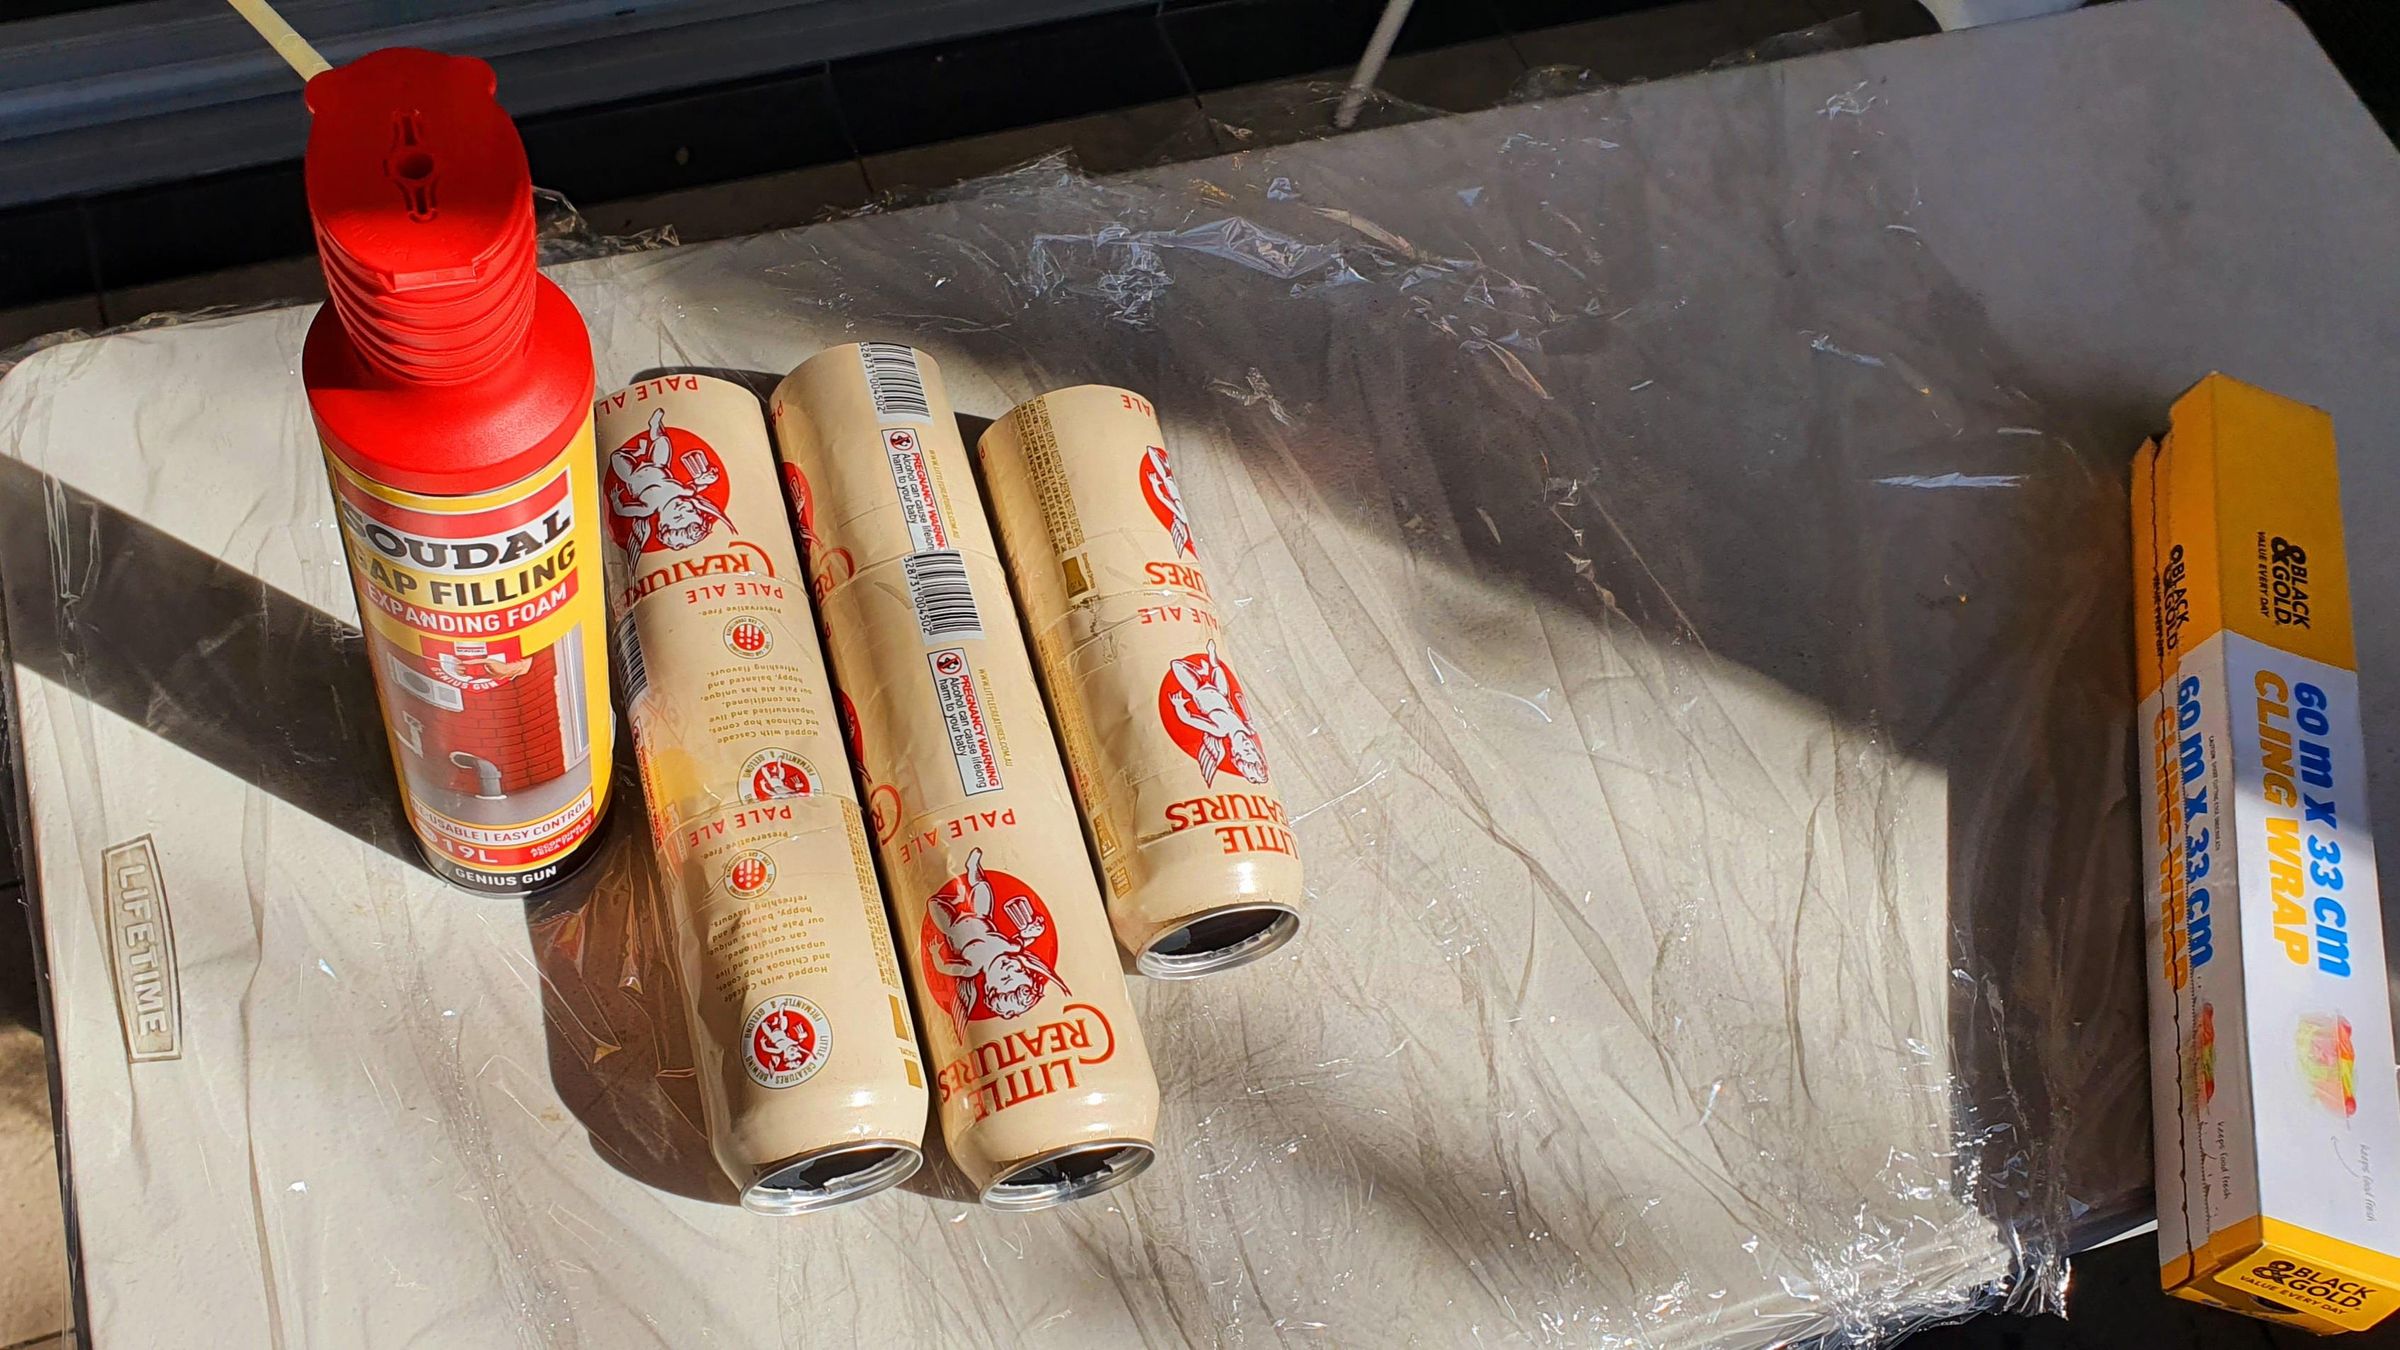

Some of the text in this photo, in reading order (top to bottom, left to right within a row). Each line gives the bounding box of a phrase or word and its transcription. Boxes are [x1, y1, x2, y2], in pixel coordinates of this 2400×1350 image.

[594, 376, 698, 424] PALE AL
[1120, 394, 1150, 417] ALE
[892, 454, 919, 525] harm to your baby
[901, 453, 935, 551] Alcohol can cause lifelon
[912, 452, 946, 549] PREGNANCY WARNIN
[342, 500, 571, 570] SOUDAL
[351, 540, 576, 606] GAP FILLING
[686, 582, 784, 604] PALE ALE
[2257, 531, 2270, 618] VALUE EVERY DAY
[2271, 536, 2311, 629] & BLACK
[367, 582, 567, 633] EXPANDING FOAM
[2172, 562, 2190, 630] BLACK
[1138, 606, 1221, 632] ALE ALE
[707, 680, 725, 690] and
[729, 674, 772, 685] balanced
[709, 714, 727, 723] live
[731, 709, 748, 718] and
[939, 678, 967, 756] harm to your baby
[2178, 675, 2202, 726] 60
[2295, 682, 2329, 736] 60
[717, 731, 757, 743] Cascade
[950, 677, 987, 789] Alcohol can cause lifelong
[960, 674, 999, 787] PREGNANCY WARNING
[494, 831, 529, 842] EASY
[533, 800, 588, 835] CONTROL
[689, 805, 792, 848] PALE ALE
[1165, 793, 1290, 832] EATURES
[2254, 669, 2310, 966] CLING WRAP
[726, 831, 789, 850] Preservative
[900, 808, 1016, 864] PALE ALE
[1215, 825, 1299, 860] LITTLE
[456, 866, 557, 886] GENIUS GUN
[2186, 827, 2210, 886] 33
[2307, 834, 2344, 892] 33
[711, 895, 807, 928] refreshing flavours.
[712, 906, 813, 942] hoppy, balanced and
[761, 925, 778, 933] Ale
[782, 919, 804, 928] Pale
[2159, 849, 2188, 991] WRAP
[2187, 888, 2214, 969] cm
[118, 864, 167, 1036] LIFETIME
[741, 931, 758, 940] has
[790, 931, 807, 939] can
[2313, 896, 2351, 978] cm
[715, 941, 826, 980] unpasteurised and live
[744, 967, 763, 978] hop
[767, 956, 809, 971] Chinook
[812, 952, 831, 962] and
[724, 966, 828, 1002] Hopped with Cascade
[784, 997, 823, 1022] FREMANTLE
[745, 1055, 769, 1081] BREWING
[775, 1062, 816, 1084] CREATURES
[938, 1003, 1116, 1104] CREATURES
[968, 1058, 1080, 1123] LITTLE
[2240, 1275, 2347, 1315] VALUE EVERY DAY
[2252, 1260, 2377, 1299] & BLACK
